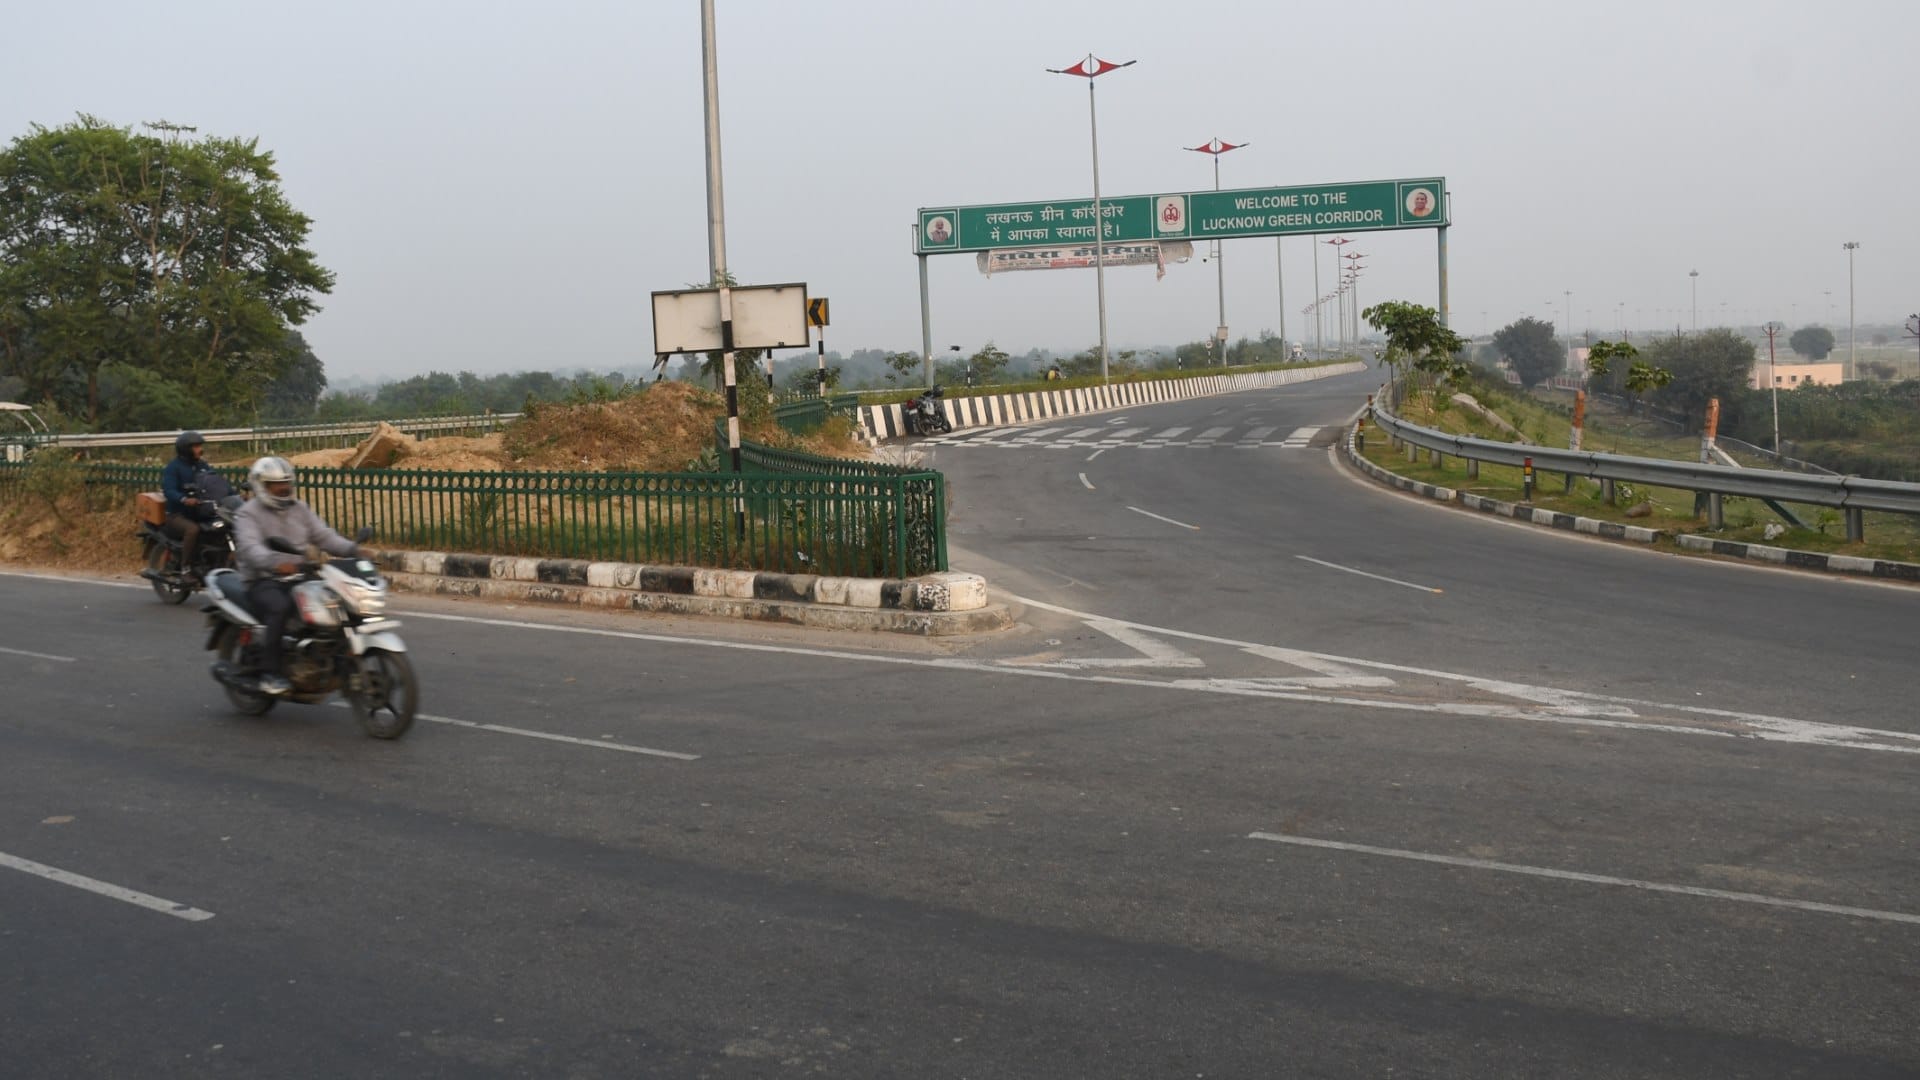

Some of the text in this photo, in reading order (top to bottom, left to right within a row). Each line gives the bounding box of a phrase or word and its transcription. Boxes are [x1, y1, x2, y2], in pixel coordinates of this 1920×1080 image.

[1235, 192, 1348, 209] WELCOME TO THE
[986, 211, 1033, 225] लखनऊ
[1040, 206, 1064, 221] ग्रीन
[1202, 210, 1383, 231] LUCKNOW GREEN CORRIDOR
[990, 226, 1000, 242] में
[1008, 228, 1048, 241] आपका
[1056, 226, 1096, 238] स्वागत
